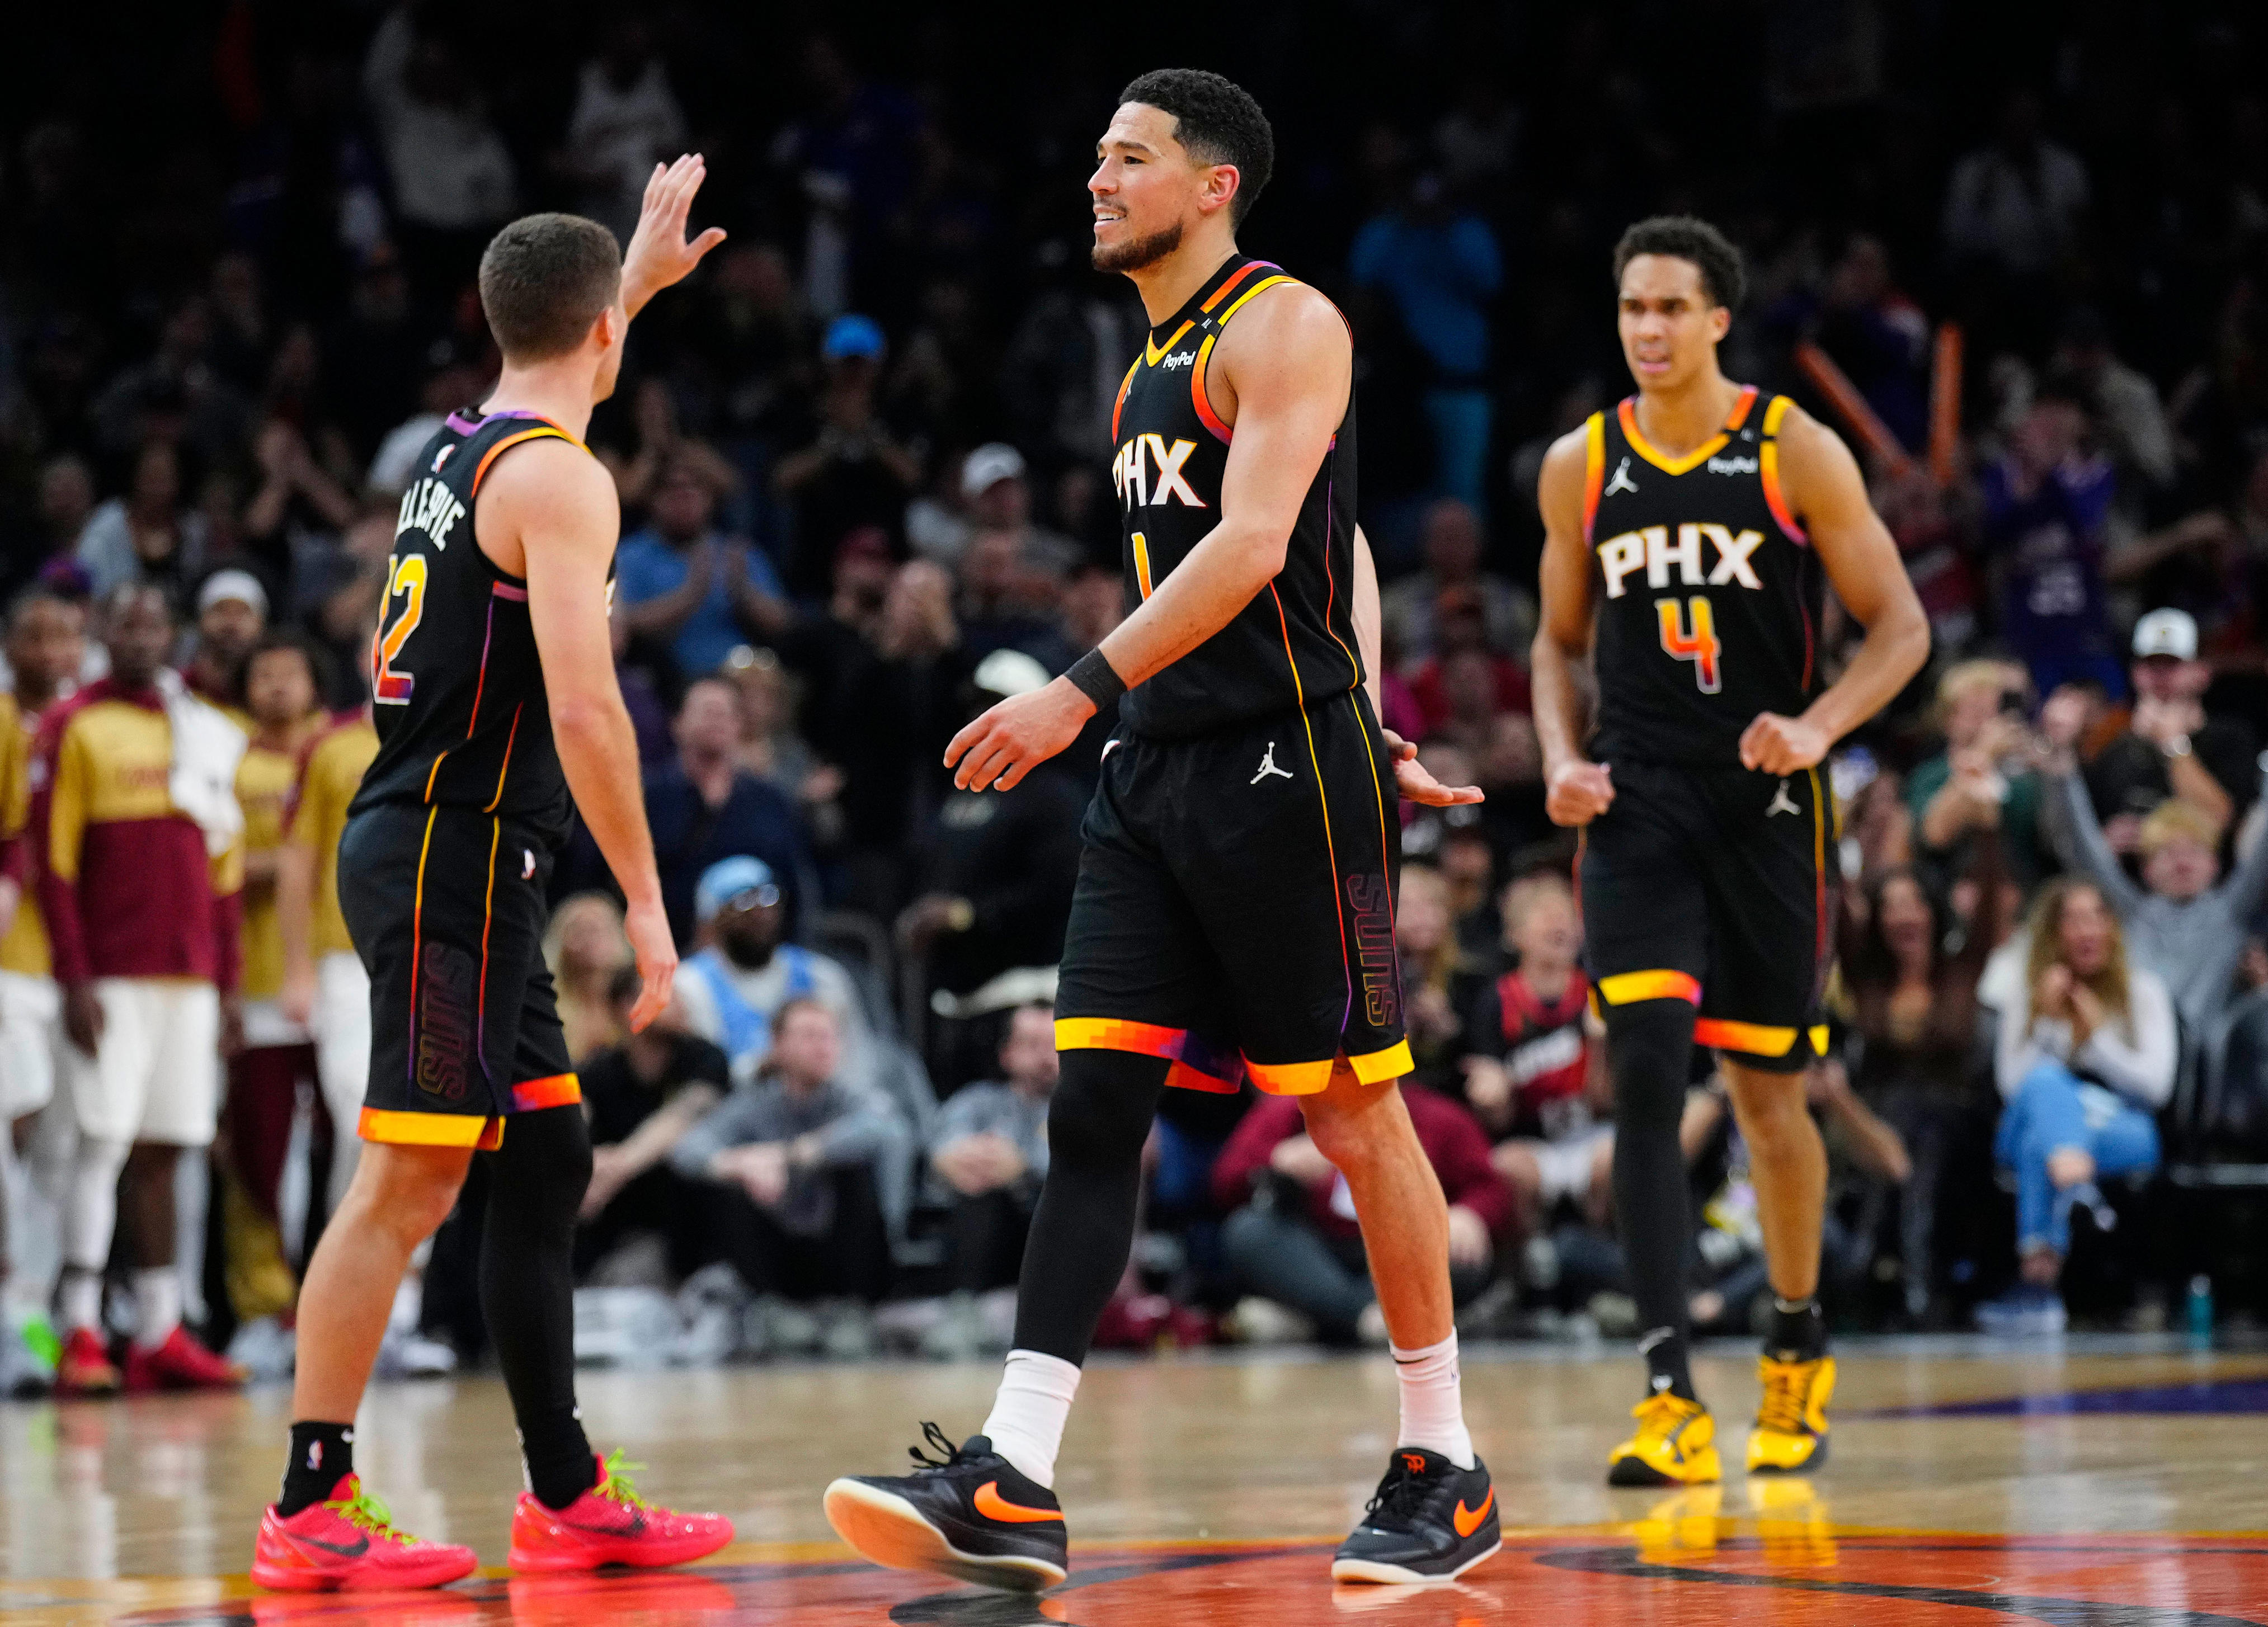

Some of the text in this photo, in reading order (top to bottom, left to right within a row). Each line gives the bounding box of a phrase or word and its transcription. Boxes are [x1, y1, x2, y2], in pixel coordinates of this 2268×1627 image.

[1162, 351, 1196, 371] PayPal
[1112, 432, 1209, 513] PHX
[1596, 522, 1767, 600] PHX
[1654, 596, 1723, 695] 4
